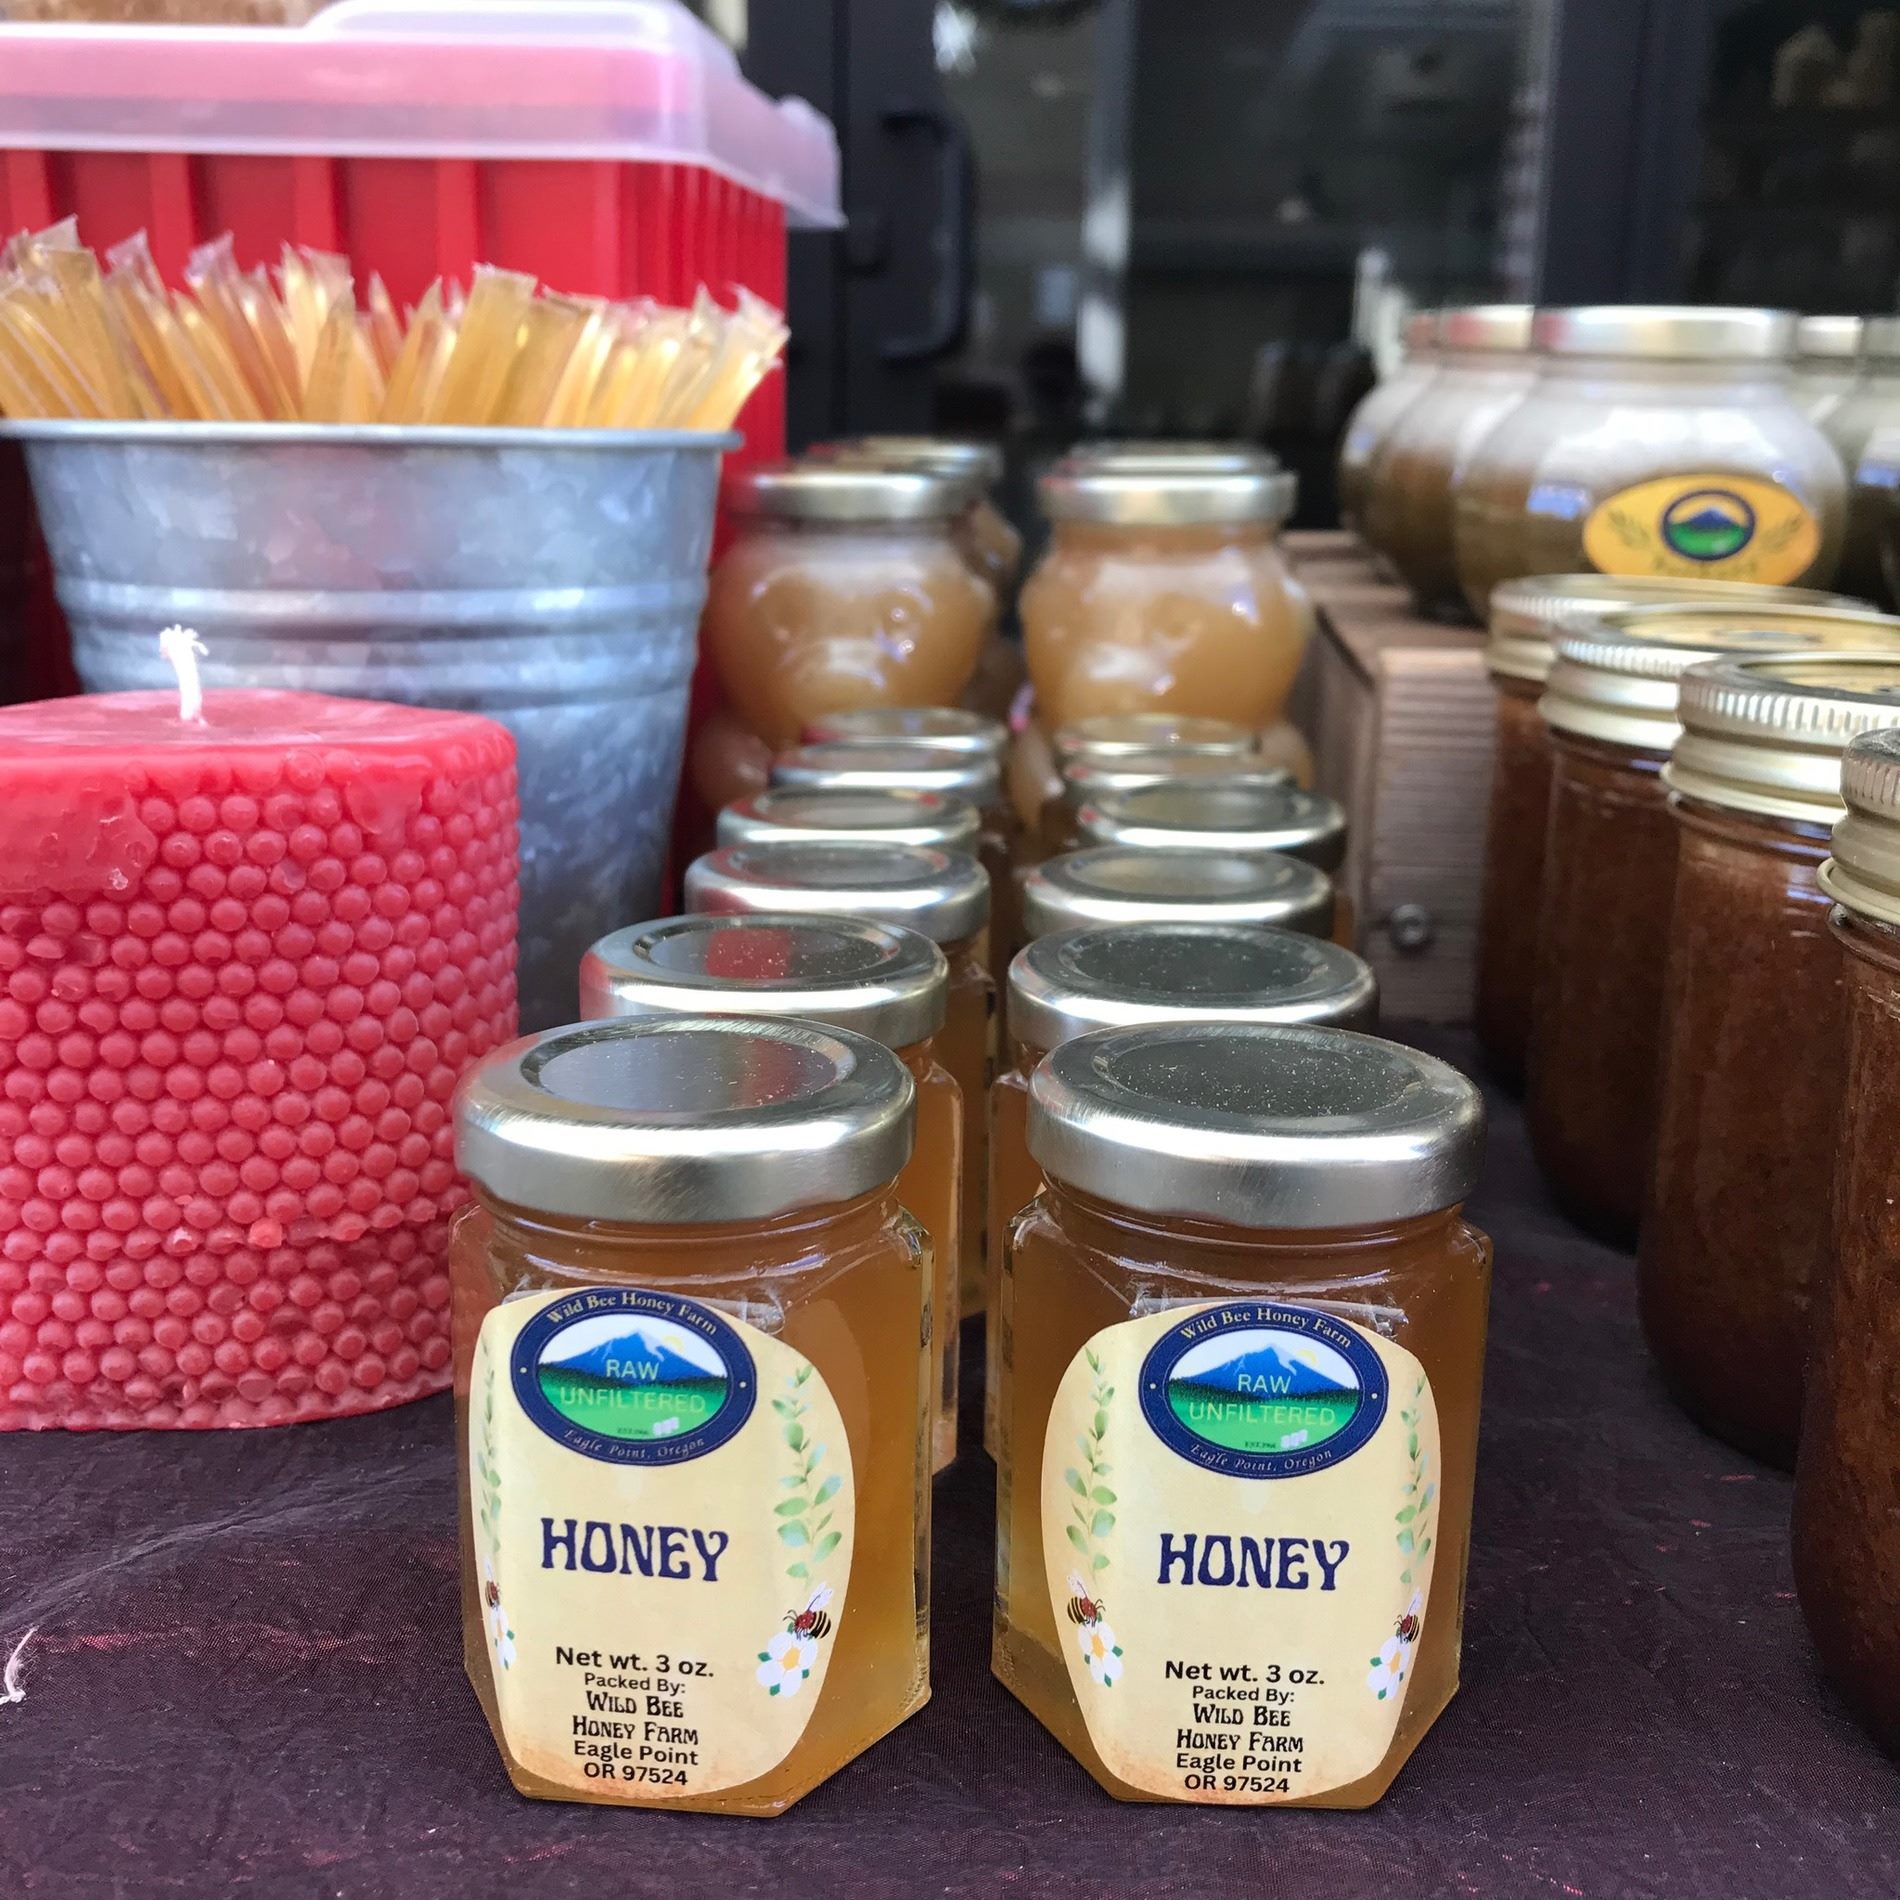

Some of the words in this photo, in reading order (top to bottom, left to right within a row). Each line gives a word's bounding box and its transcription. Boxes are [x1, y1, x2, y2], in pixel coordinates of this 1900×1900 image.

[546, 1300, 583, 1324] Wild
[587, 1294, 616, 1308] Bee
[622, 1292, 674, 1313] Honey
[679, 1305, 717, 1336] Farm
[1180, 1315, 1217, 1341] Wild
[1221, 1310, 1251, 1324] Bee
[1257, 1307, 1310, 1329] Honey
[1313, 1319, 1351, 1349] Farm
[605, 1359, 659, 1381] RAW
[1237, 1374, 1292, 1394] RAW
[559, 1386, 706, 1413] UNFILTERED
[1189, 1402, 1336, 1426] UNFILTERED
[564, 1429, 603, 1451] Eagle
[657, 1438, 705, 1457] Oregon
[1190, 1443, 1229, 1466] Eagle
[1284, 1450, 1332, 1470] Oregon
[541, 1518, 729, 1582] HONEY
[1157, 1533, 1350, 1591] HONEY
[555, 1646, 602, 1667] Net
[609, 1654, 648, 1671] wt.
[655, 1655, 670, 1673] 3
[678, 1660, 714, 1677] oz.
[1165, 1660, 1212, 1680] Net
[1219, 1664, 1258, 1682] wt.
[1265, 1665, 1281, 1683] 3
[1289, 1669, 1325, 1685] oz.
[584, 1672, 650, 1691] Packed
[657, 1679, 685, 1696] By:
[1192, 1685, 1259, 1701] Packed
[1266, 1689, 1295, 1706] By:
[574, 1740, 632, 1762] Eagle
[639, 1746, 699, 1766] Point
[1176, 1753, 1235, 1774] Eagle
[1243, 1755, 1302, 1772] Point
[584, 1762, 615, 1780] OR
[622, 1765, 688, 1786] 97524
[1184, 1774, 1216, 1790] OR
[1224, 1775, 1290, 1793] 97524
